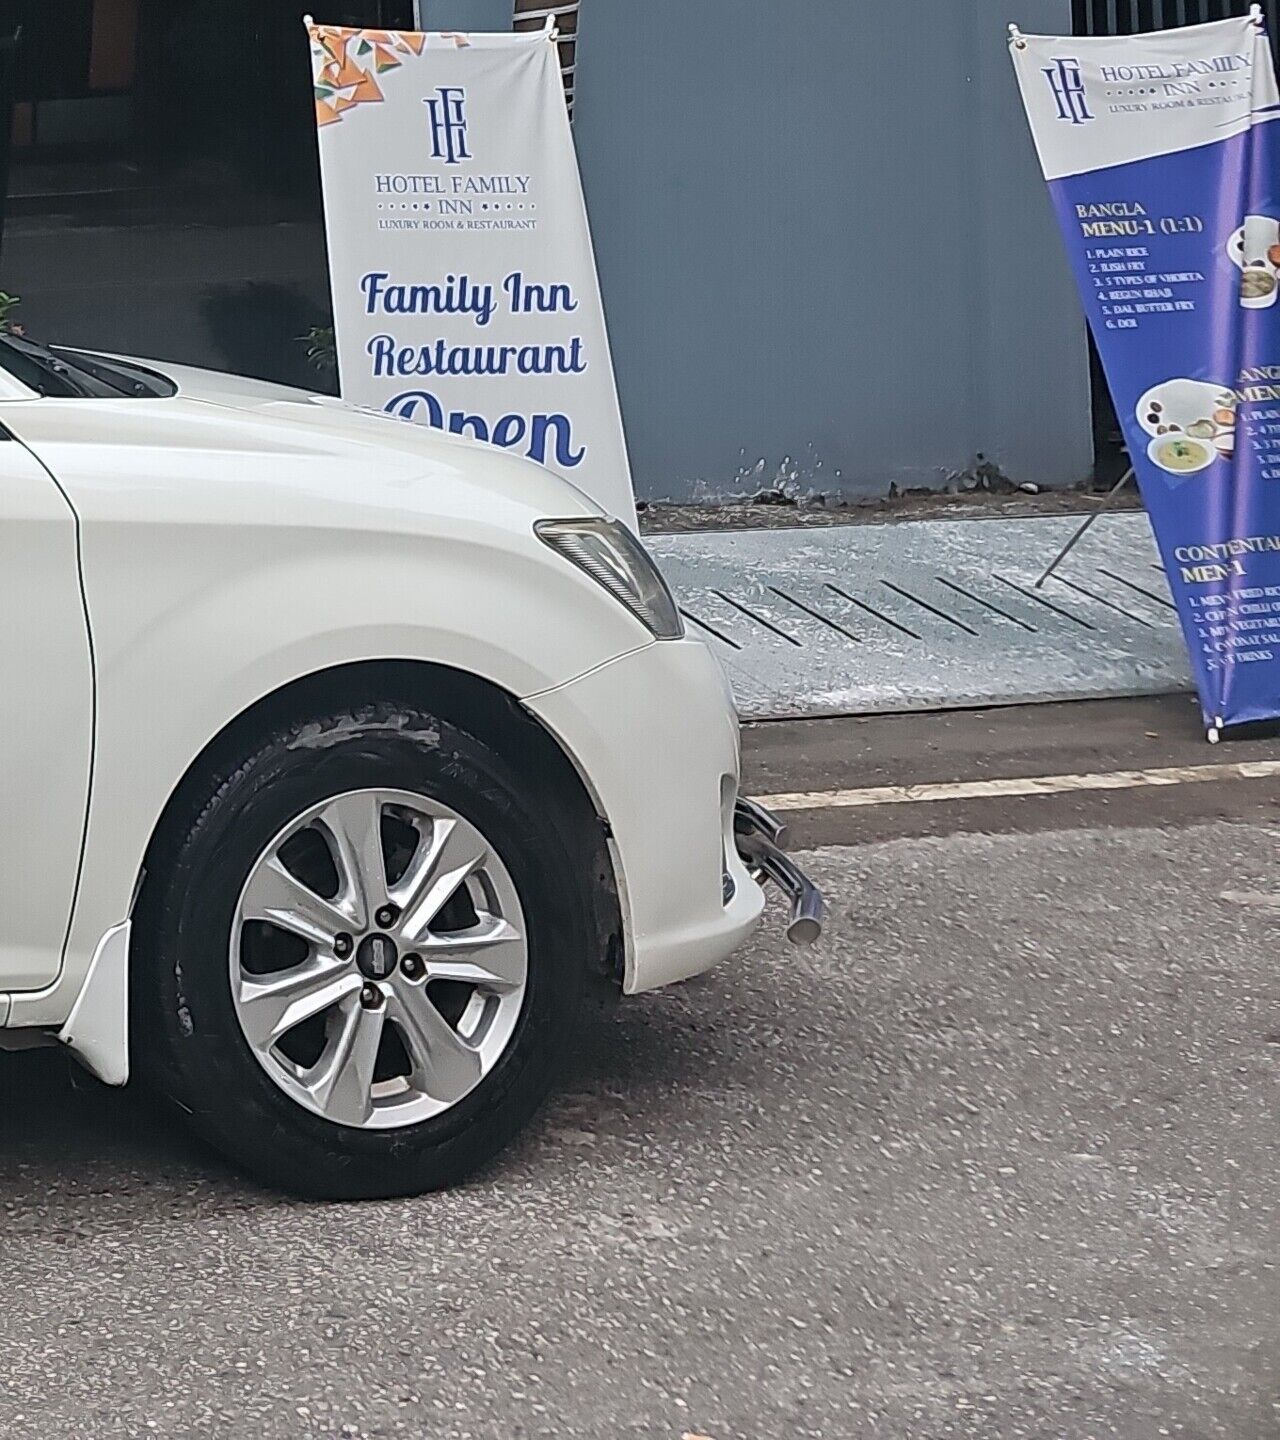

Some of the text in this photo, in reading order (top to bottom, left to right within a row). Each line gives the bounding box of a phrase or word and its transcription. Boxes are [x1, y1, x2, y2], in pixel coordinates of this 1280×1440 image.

[1101, 52, 1253, 82] HOTEL FAMILY
[1162, 80, 1202, 97] INN
[376, 175, 530, 194] HOTEL FAMILY
[438, 199, 473, 214] INN
[1075, 202, 1147, 218] BANGLA
[379, 220, 537, 230] LUXURY ROOM & RESTAURANT
[1080, 216, 1203, 238] MENU-1 (1:1)
[361, 273, 578, 326] Family Inn
[367, 335, 587, 376] Restaurant
